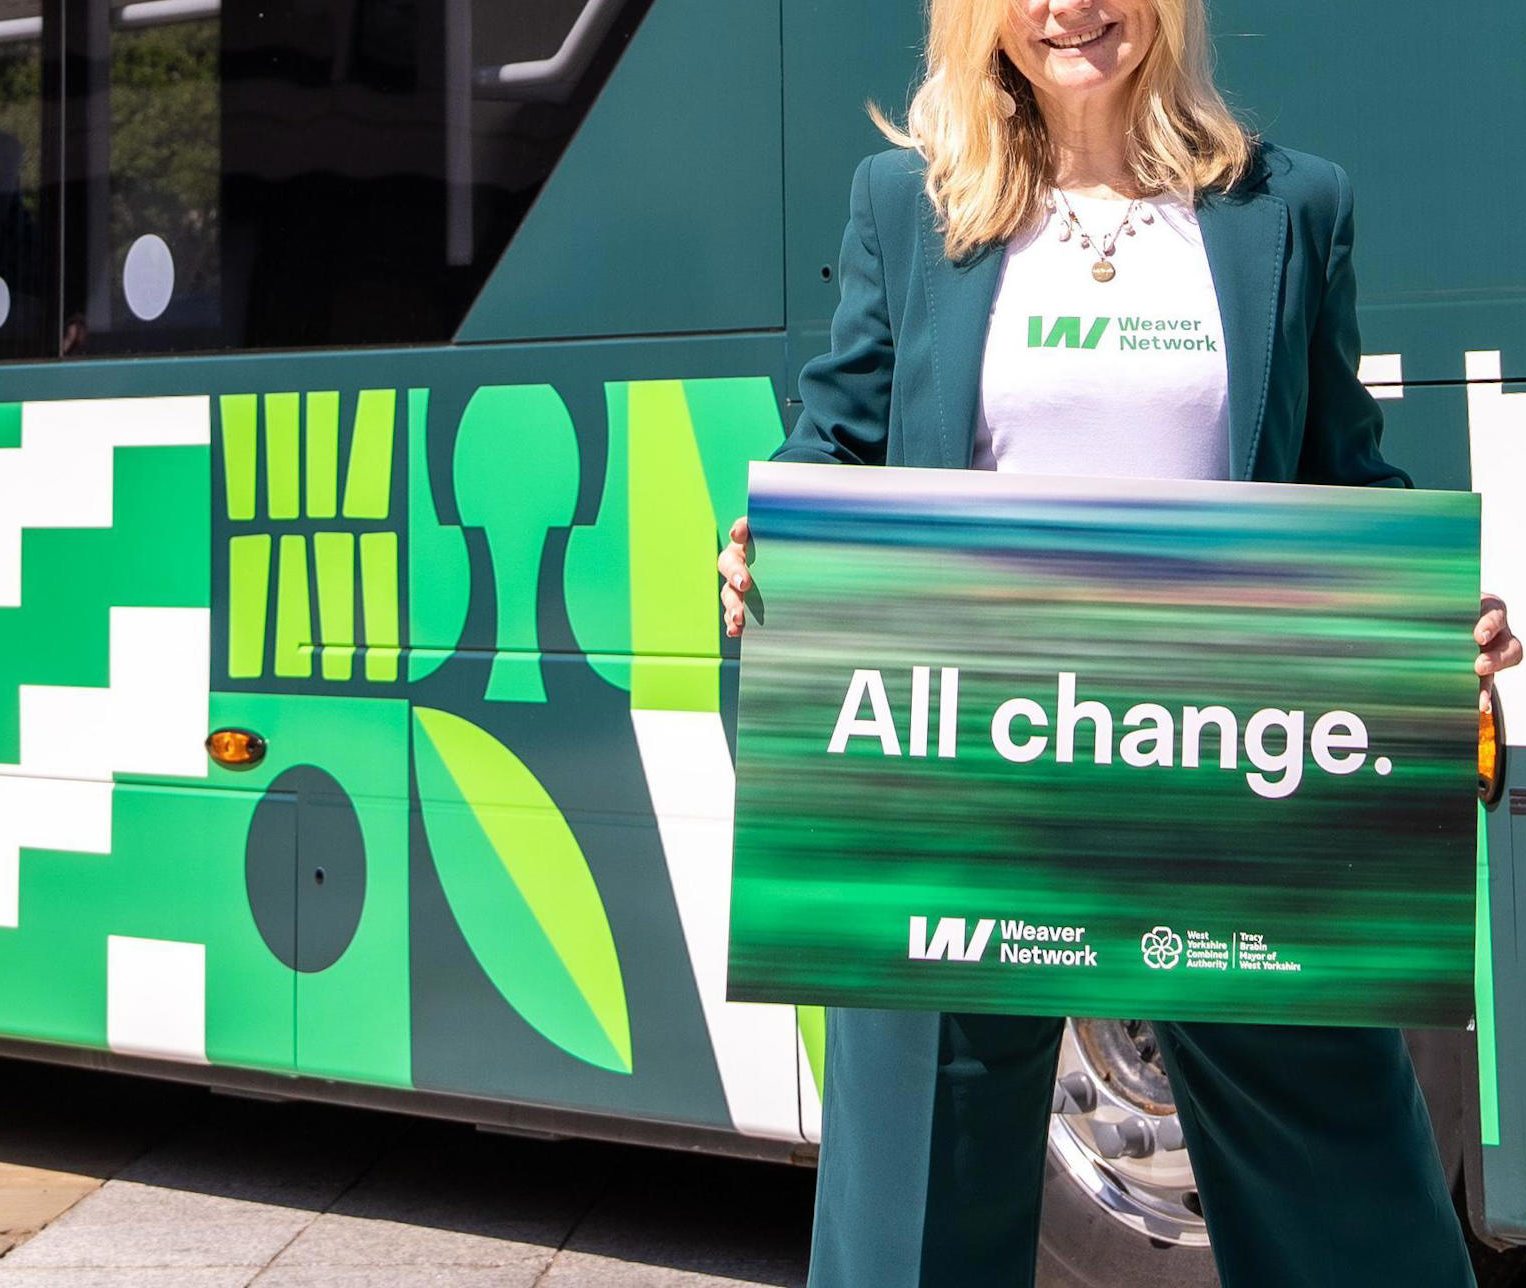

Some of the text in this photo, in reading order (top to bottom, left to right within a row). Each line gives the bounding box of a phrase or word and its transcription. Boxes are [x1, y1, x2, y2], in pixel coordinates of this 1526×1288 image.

[1118, 316, 1202, 331] Weaver
[1120, 334, 1218, 352] Network
[828, 666, 1392, 799] All change.
[1001, 920, 1086, 943] Weaver
[1187, 930, 1209, 940] West
[1240, 932, 1263, 943] Tracy
[1187, 940, 1227, 950] Yorkshire
[1240, 942, 1267, 951] Brabin
[1001, 943, 1098, 966] Network
[1187, 950, 1228, 960] Combined
[1240, 951, 1277, 961] Mayor of
[1187, 959, 1228, 971] Authority
[1239, 961, 1261, 970] West
